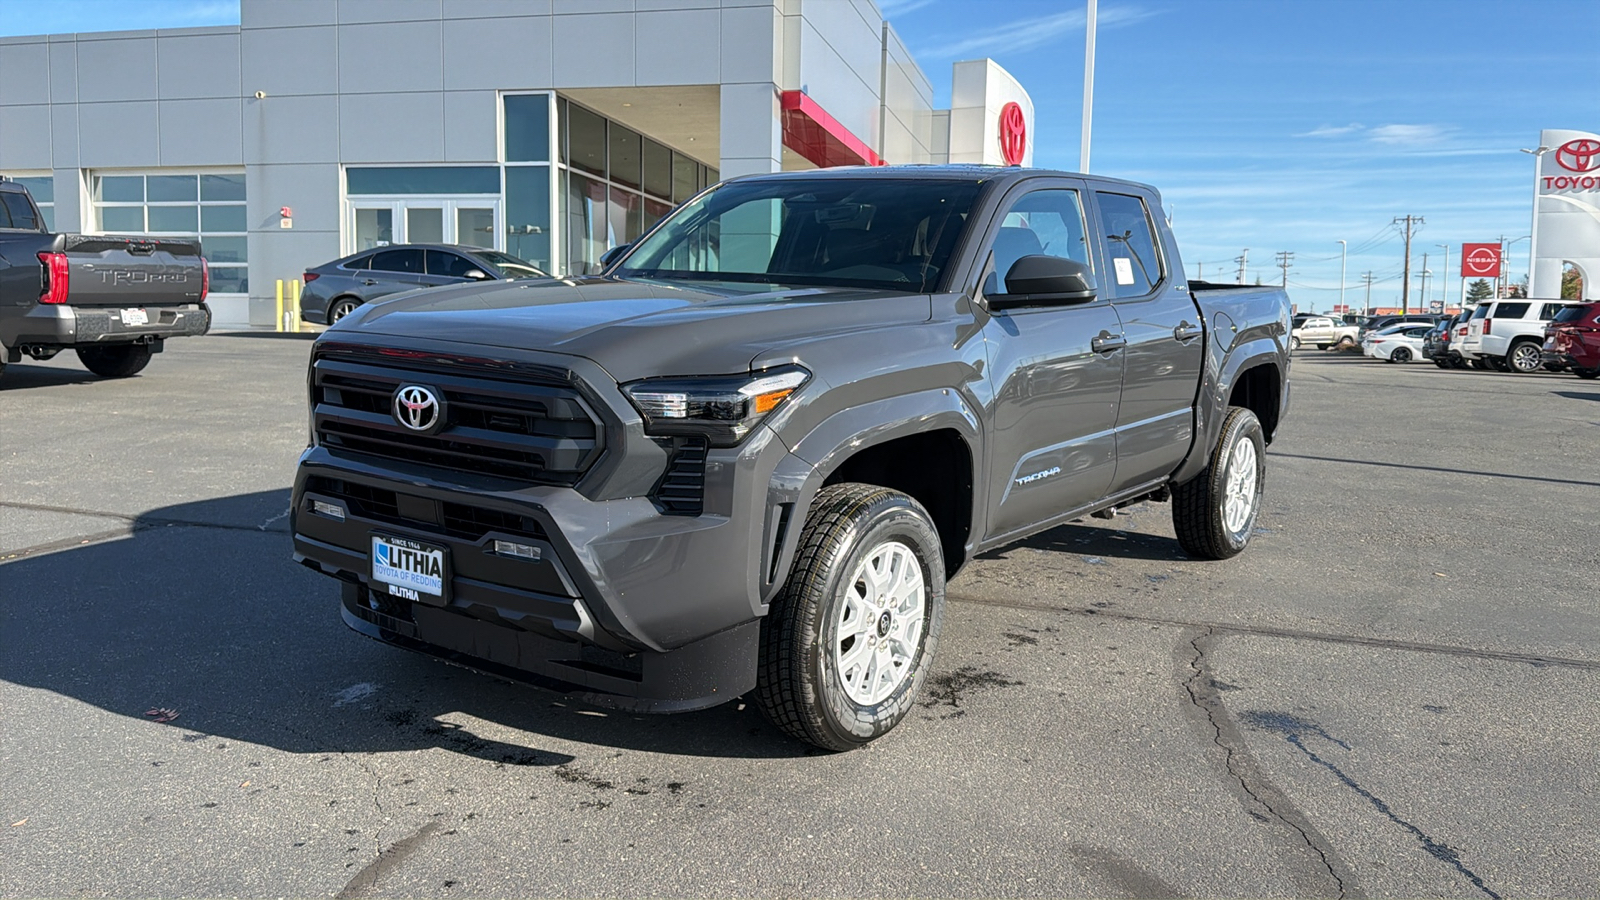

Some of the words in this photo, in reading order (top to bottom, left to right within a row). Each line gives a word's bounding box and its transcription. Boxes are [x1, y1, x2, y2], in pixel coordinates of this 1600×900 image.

[94, 269, 148, 286] TRD
[149, 273, 188, 283] PRO
[1015, 466, 1061, 486] TACOMA
[391, 537, 407, 547] SINCE
[389, 546, 442, 578] LITHIA
[375, 564, 399, 579] TOYOTA
[400, 571, 410, 580] OF
[411, 573, 442, 588] REDDING
[395, 585, 420, 602] LITHIA
